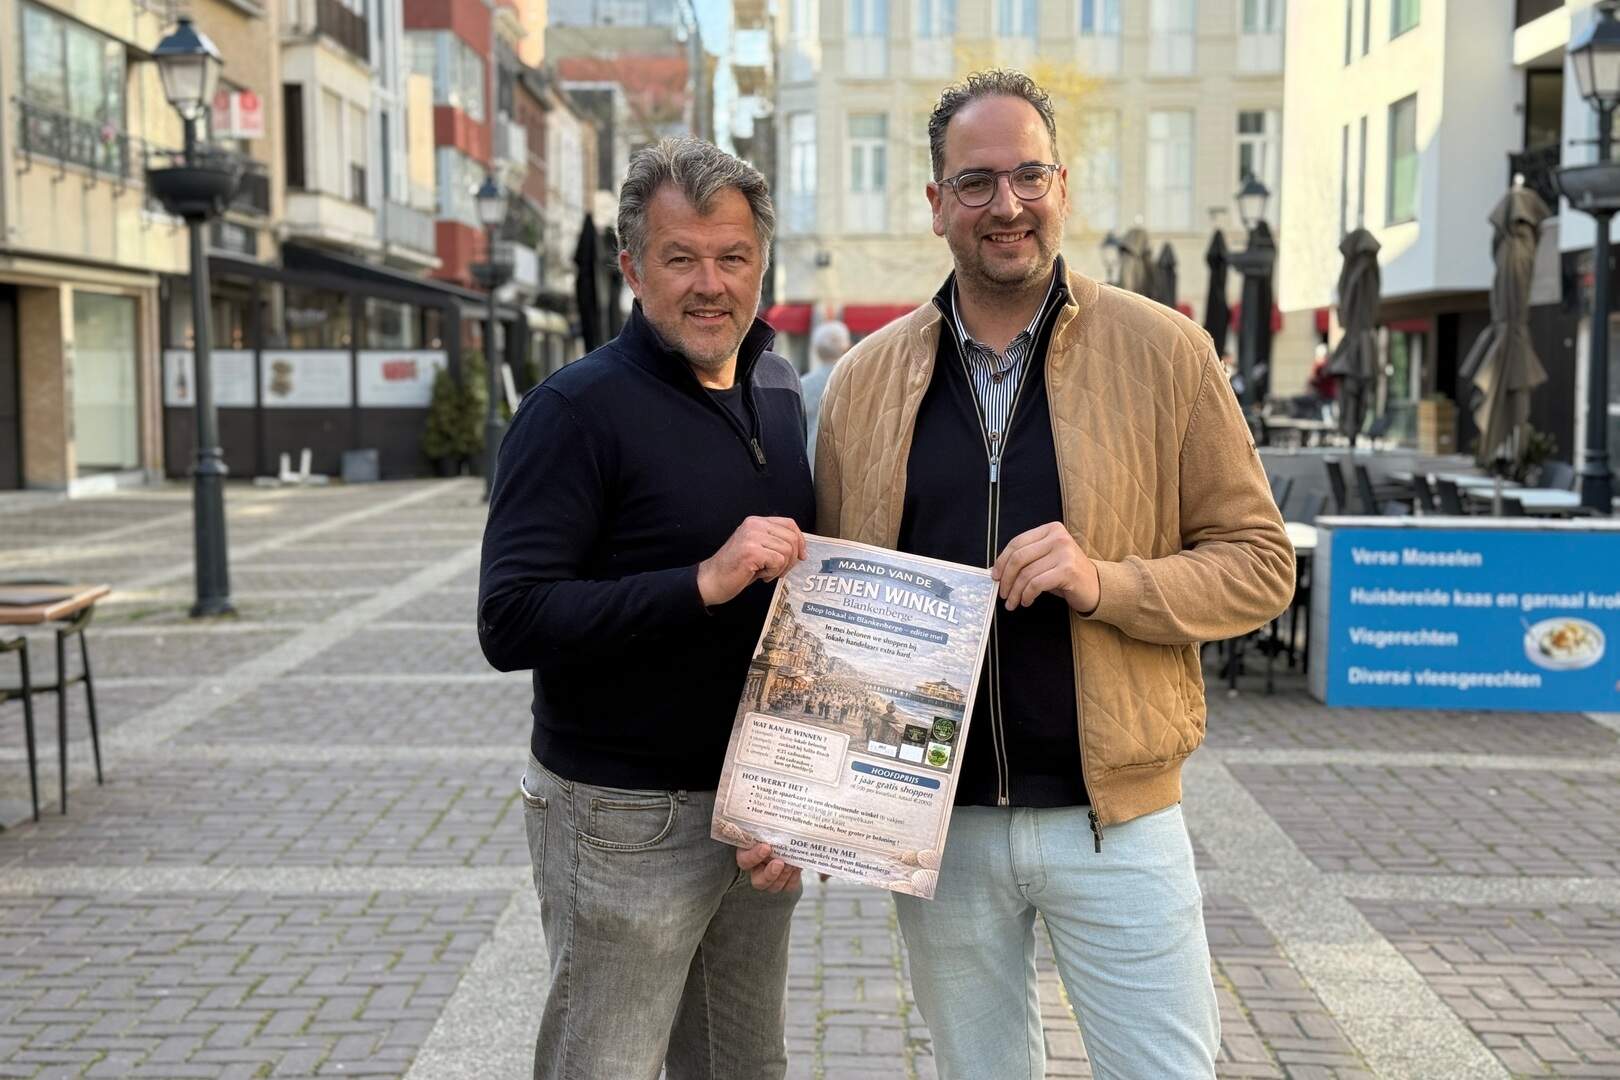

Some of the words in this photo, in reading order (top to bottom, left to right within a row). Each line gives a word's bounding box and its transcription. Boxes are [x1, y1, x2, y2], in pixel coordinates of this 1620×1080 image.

[1352, 548, 1398, 565] Verse
[1402, 549, 1482, 567] Mosselen
[838, 560, 885, 576] MAAND
[889, 569, 913, 582] VAN
[916, 577, 932, 588] DE
[803, 574, 880, 599] STENEN
[886, 584, 960, 625] WINKEL
[842, 598, 913, 622] Blankenberge
[1350, 587, 1449, 606] Huisbereide
[1454, 590, 1492, 607] kaas
[1496, 594, 1518, 608] en
[1521, 592, 1584, 611] garnaal
[806, 604, 824, 617] Shop
[825, 608, 847, 620] lokaal
[848, 613, 855, 622] in
[857, 616, 903, 634] Blankenberge
[910, 628, 928, 639] editie
[930, 632, 944, 641] mei
[824, 624, 832, 632] In
[833, 626, 844, 634] mei
[846, 628, 872, 640] belonen
[872, 634, 882, 642] we
[882, 634, 908, 650] shoppen
[909, 642, 917, 652] bij
[825, 633, 844, 644] lokale
[846, 637, 878, 652] handelaars
[880, 646, 895, 655] extra
[1349, 628, 1458, 648] Visgerechten
[1348, 667, 1412, 684] Diverse
[1415, 670, 1542, 690] vleesgerechten
[753, 720, 767, 728] WAT
[768, 724, 784, 732] KAN
[793, 730, 823, 741] WINNEN
[742, 773, 759, 781] HOE
[760, 777, 787, 788] WERKT
[788, 783, 804, 792] HET
[858, 776, 874, 786] jaar
[876, 781, 898, 791] gratis
[900, 785, 934, 799] shoppen
[872, 768, 919, 784] HOOFDPRIJS
[755, 786, 772, 794] Vraag
[779, 791, 807, 802] spaarkaart
[824, 802, 859, 814] deelnemende
[860, 810, 879, 819] winkel
[778, 813, 814, 826] verschillende
[848, 830, 865, 839] groter
[872, 834, 896, 846] beloning
[790, 839, 808, 848] DOE
[810, 843, 827, 851] MEE
[841, 850, 856, 858] MEI
[781, 852, 817, 863] deelnemende
[843, 866, 864, 875] winkels
[789, 847, 809, 855] nieuwe
[810, 851, 830, 859] winkels
[839, 858, 854, 866] steun
[854, 861, 891, 874] Blankenberge
